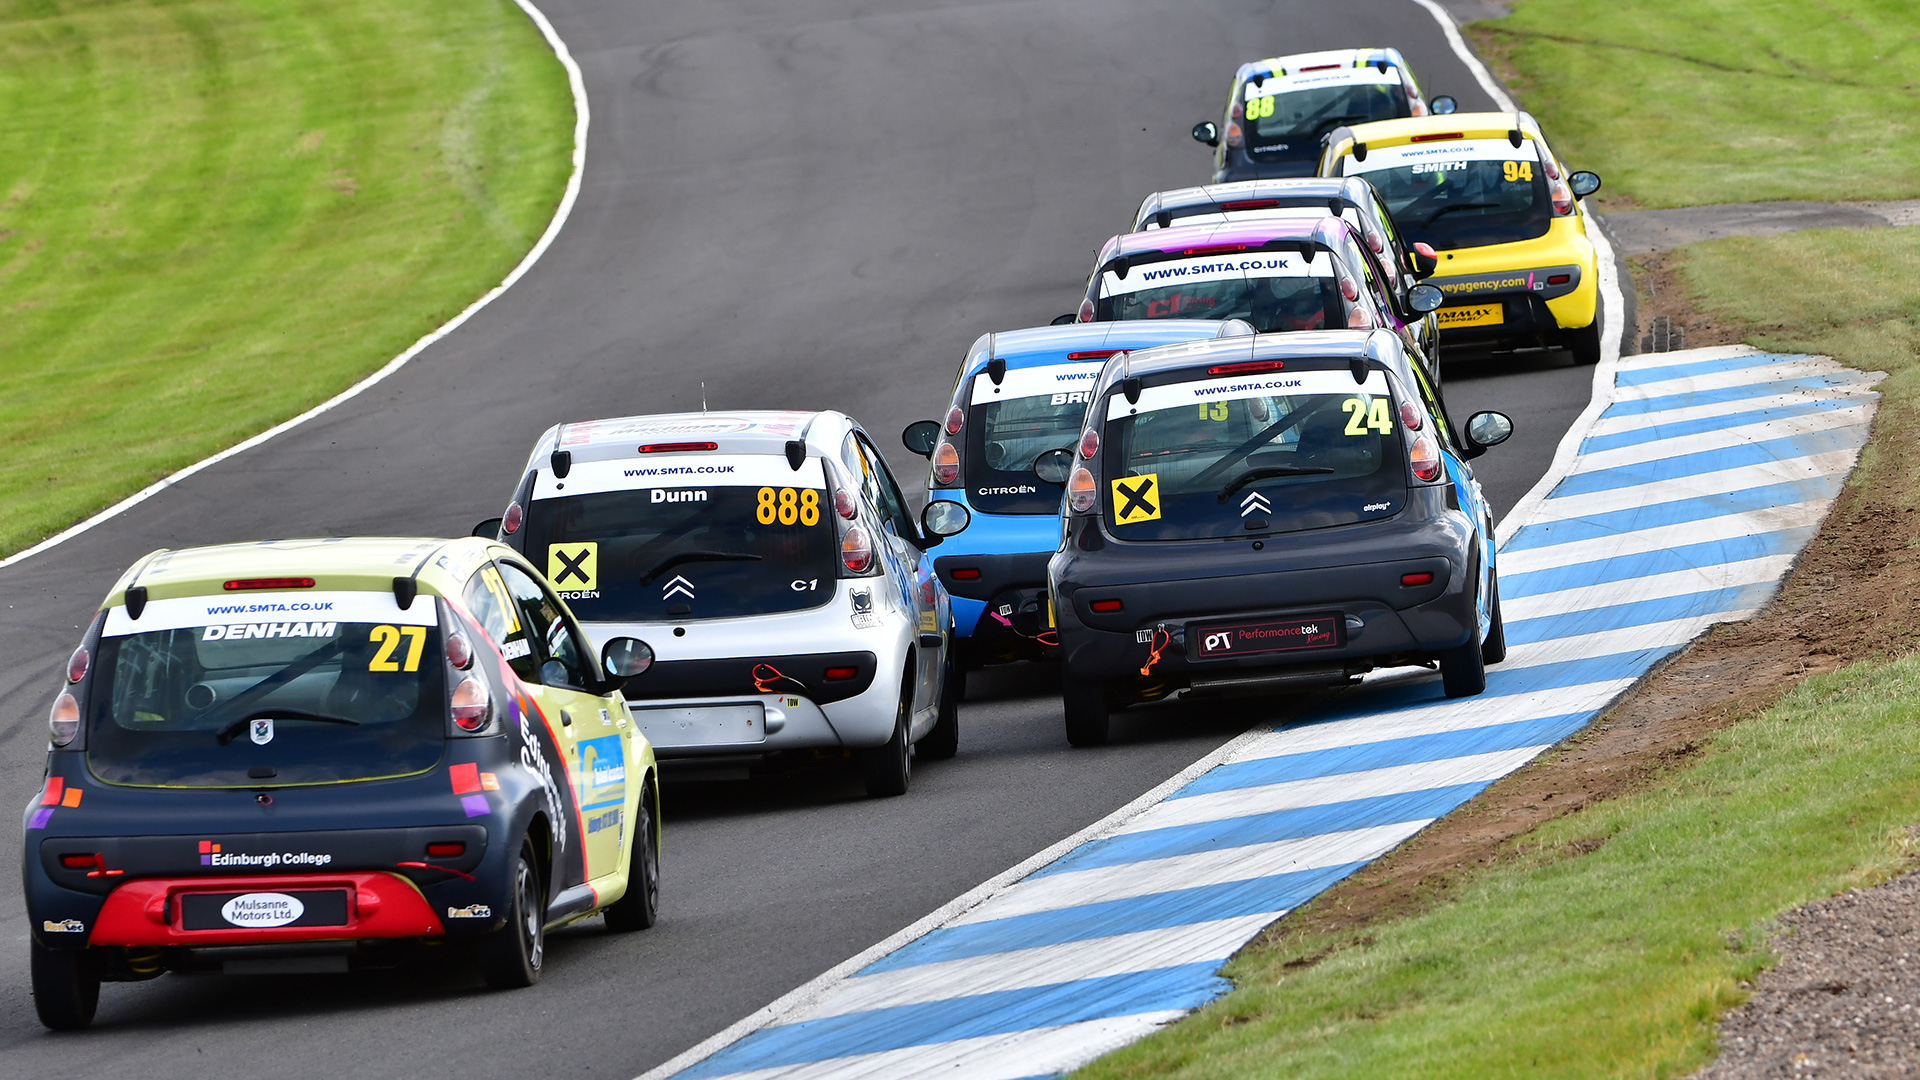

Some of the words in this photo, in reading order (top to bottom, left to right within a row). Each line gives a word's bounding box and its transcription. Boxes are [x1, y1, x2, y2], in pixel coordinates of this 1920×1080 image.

[1246, 95, 1275, 120] 88
[1401, 147, 1474, 157] WWW.SMTA.CO.UK
[1412, 160, 1467, 174] SMITH
[1503, 160, 1533, 182] 94
[1143, 259, 1289, 281] WWW.SMTA.CO.UK
[1439, 277, 1525, 293] veyagency.com
[1194, 379, 1302, 396] WWW.SMTA.CO.UK
[1199, 401, 1229, 422] 13
[1342, 398, 1393, 436] 24
[624, 466, 735, 477] WWW.SMTA.CO.UK
[650, 488, 708, 504] Dunn
[978, 485, 1036, 496] CITROËN
[756, 486, 820, 526] 888
[790, 578, 818, 591] C1
[557, 590, 600, 600] ROËN
[207, 602, 334, 615] WWW.SMTA.CO.UK
[202, 621, 337, 642] DENHAM
[1137, 630, 1152, 642] TOW
[1204, 632, 1231, 651] PT
[1239, 624, 1318, 640] Performancetek
[368, 625, 427, 672] 27
[786, 698, 799, 707] TOW
[211, 853, 281, 867] Edinburgh
[282, 852, 332, 866] College
[234, 899, 288, 911] Mulsanne
[231, 910, 272, 921] Motors
[273, 909, 295, 920] Ltd.
